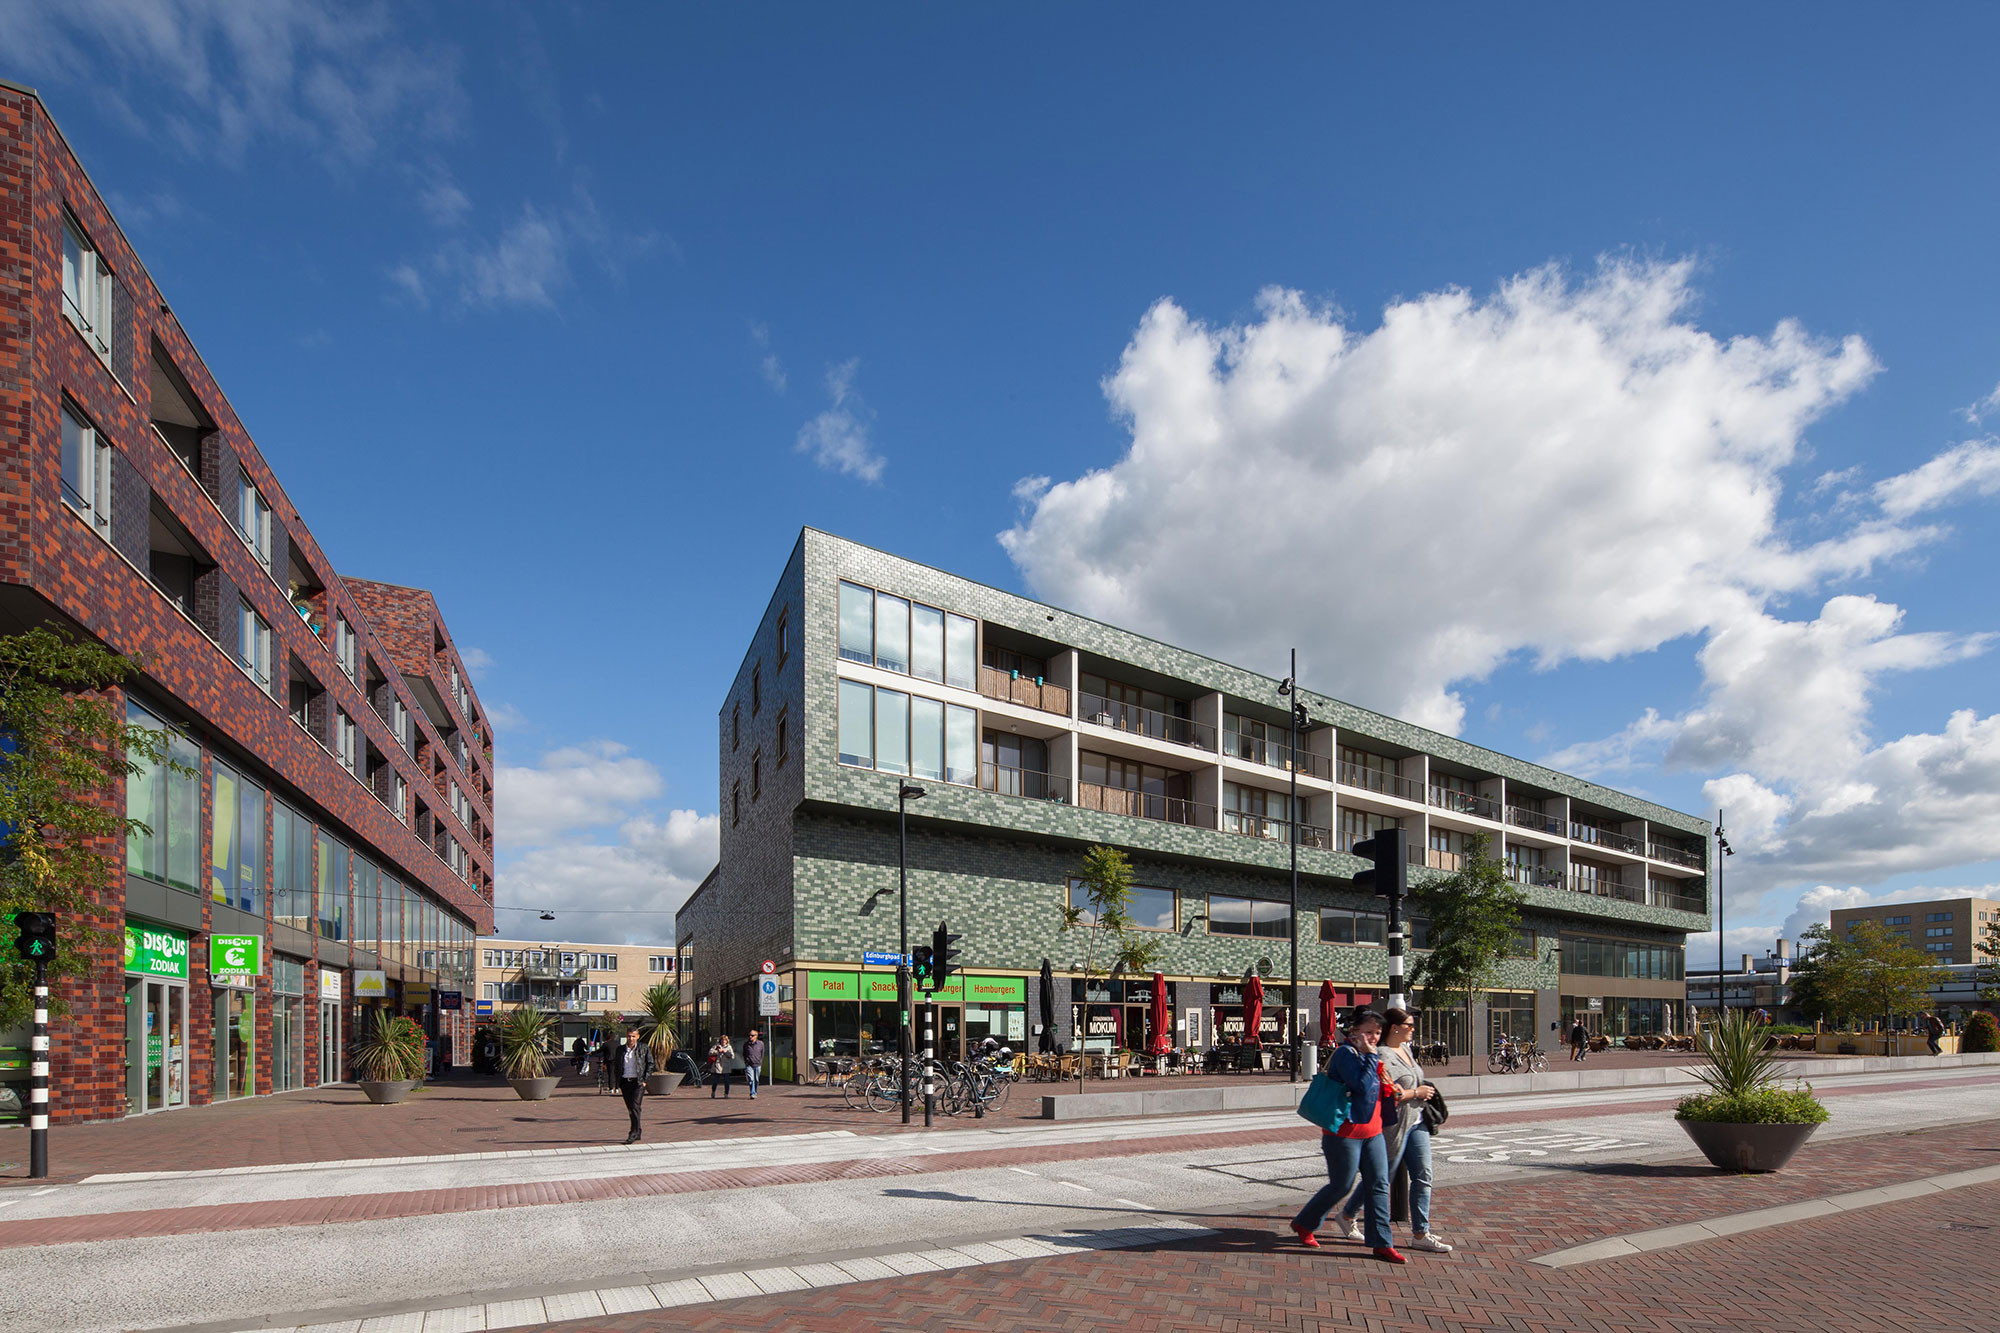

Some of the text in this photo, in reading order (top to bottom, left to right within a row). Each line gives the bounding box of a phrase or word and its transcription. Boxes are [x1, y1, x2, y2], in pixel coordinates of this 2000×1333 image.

[144, 932, 185, 958] DISCUS
[218, 938, 252, 946] DISCUS
[150, 958, 180, 974] ZODIAK
[823, 980, 845, 990] Patat
[974, 984, 1016, 995] Hamburgers
[1089, 1022, 1117, 1034] MOKUM
